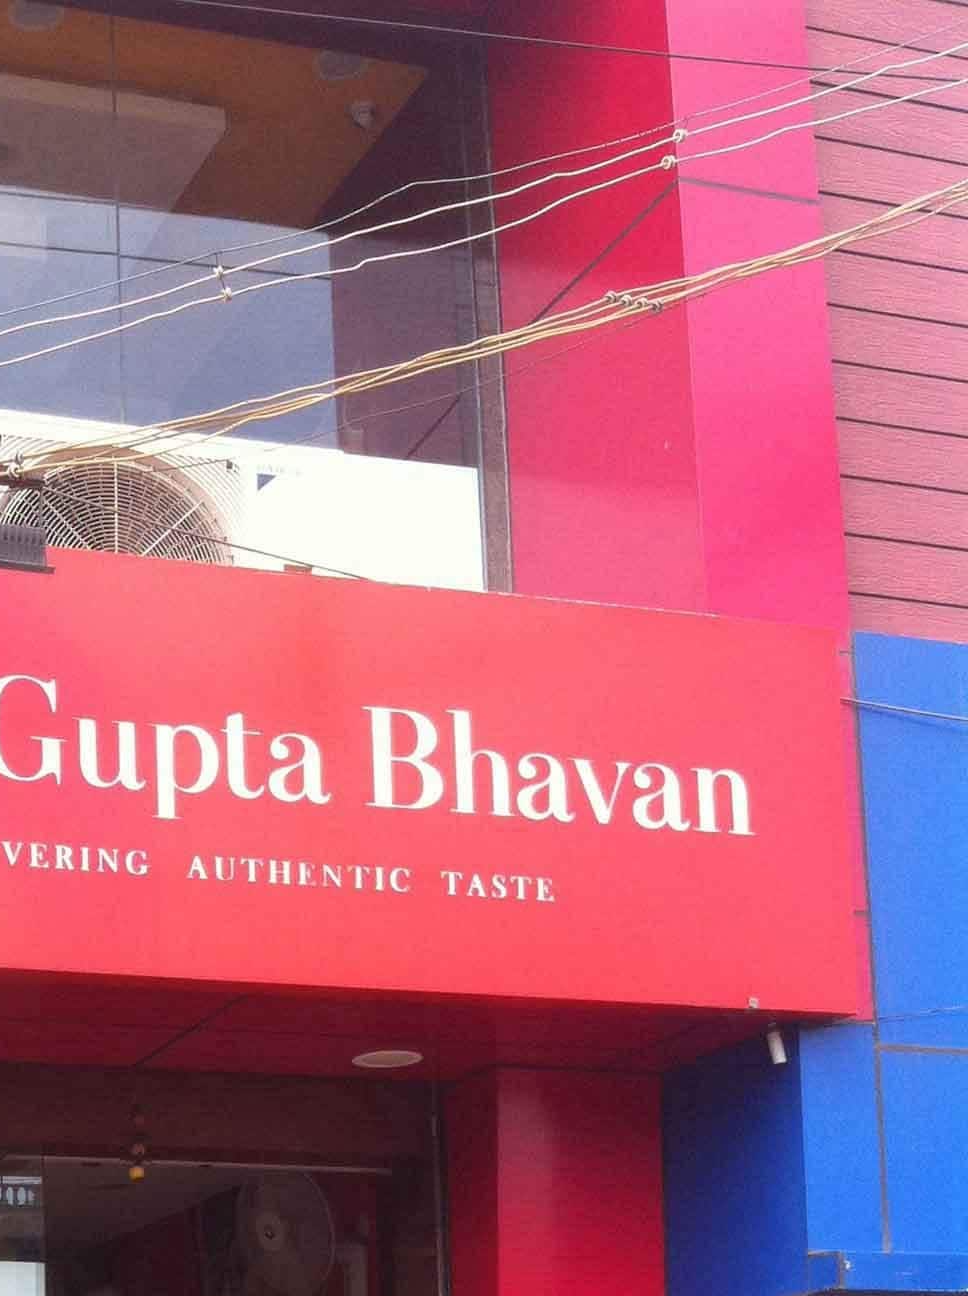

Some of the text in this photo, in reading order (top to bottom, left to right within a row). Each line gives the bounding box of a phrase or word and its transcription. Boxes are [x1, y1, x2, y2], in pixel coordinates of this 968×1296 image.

[364, 707, 755, 838] Bhavan
[187, 855, 410, 894] AUTHENTIC
[441, 871, 553, 903] TASTE
